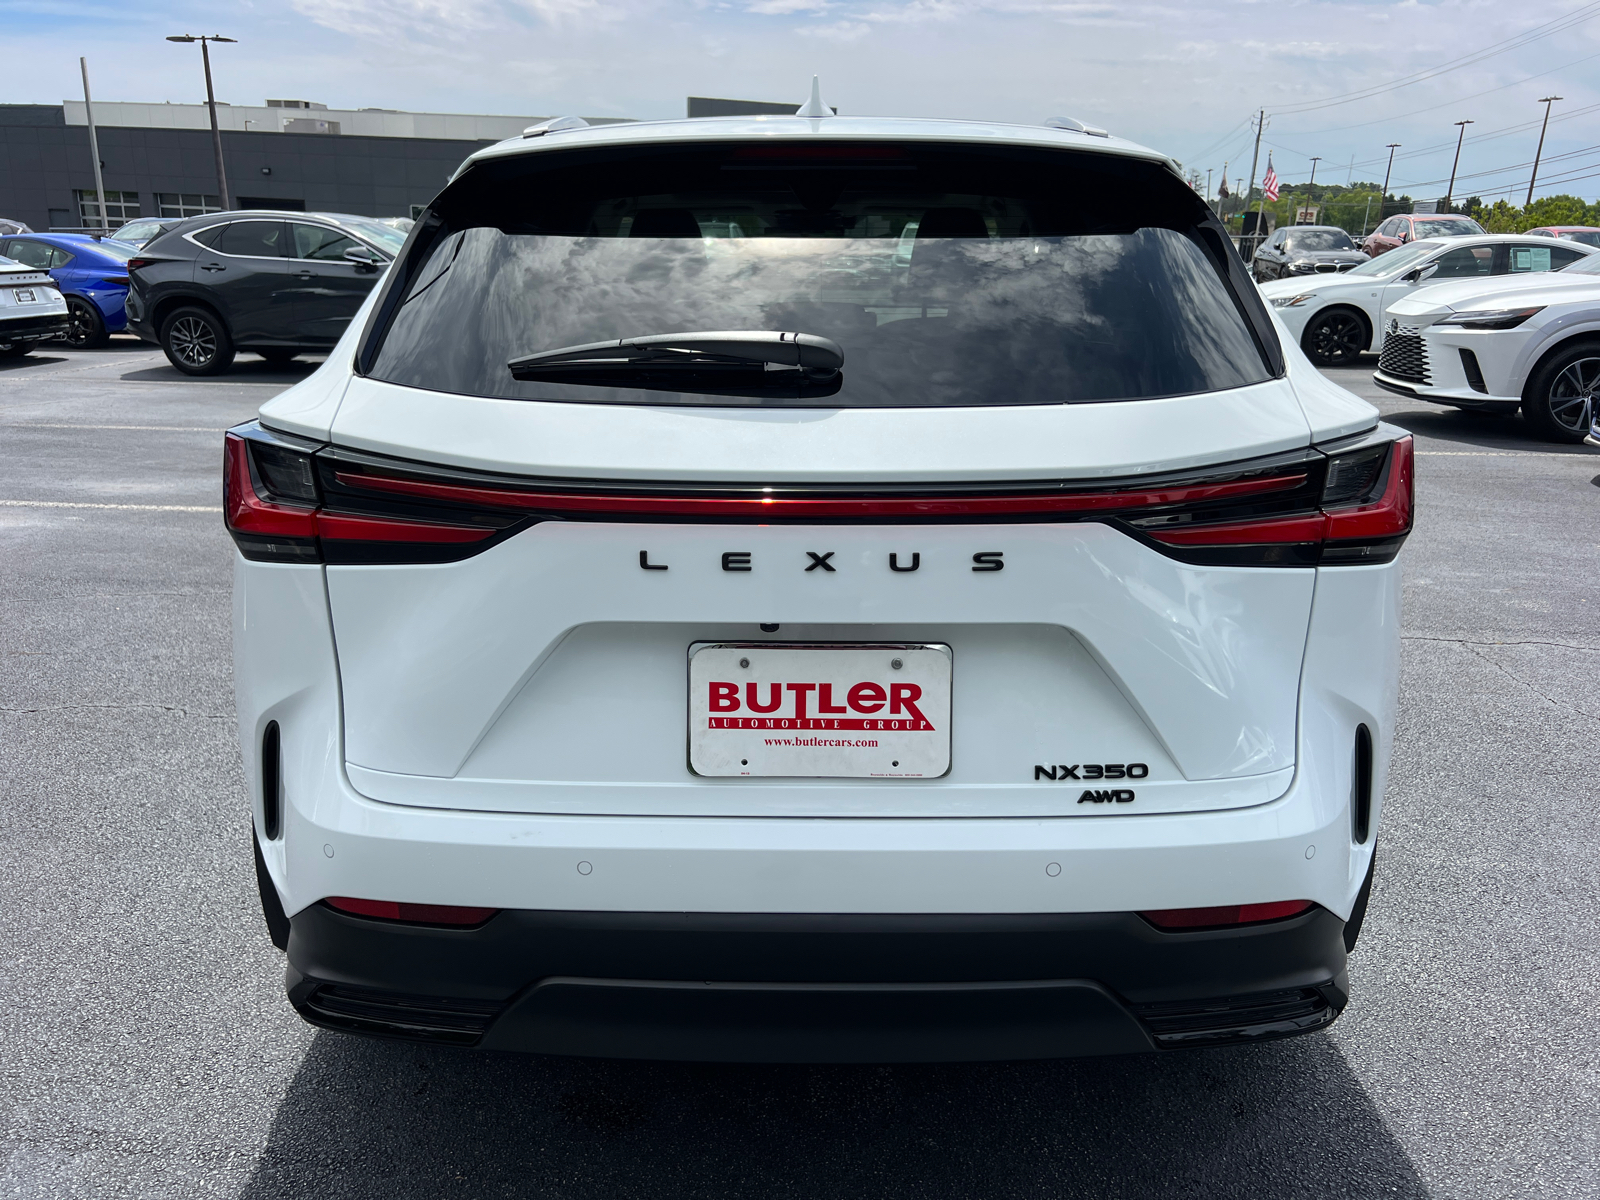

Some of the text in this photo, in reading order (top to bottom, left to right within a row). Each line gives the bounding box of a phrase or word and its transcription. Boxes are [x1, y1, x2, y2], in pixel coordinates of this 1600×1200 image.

[639, 550, 1005, 572] LEXUS
[709, 718, 927, 731] AUTOMOTIVE GROUP
[764, 736, 879, 748] www.butlercars.com
[1034, 762, 1149, 780] NX350
[1077, 789, 1135, 804] AWD
